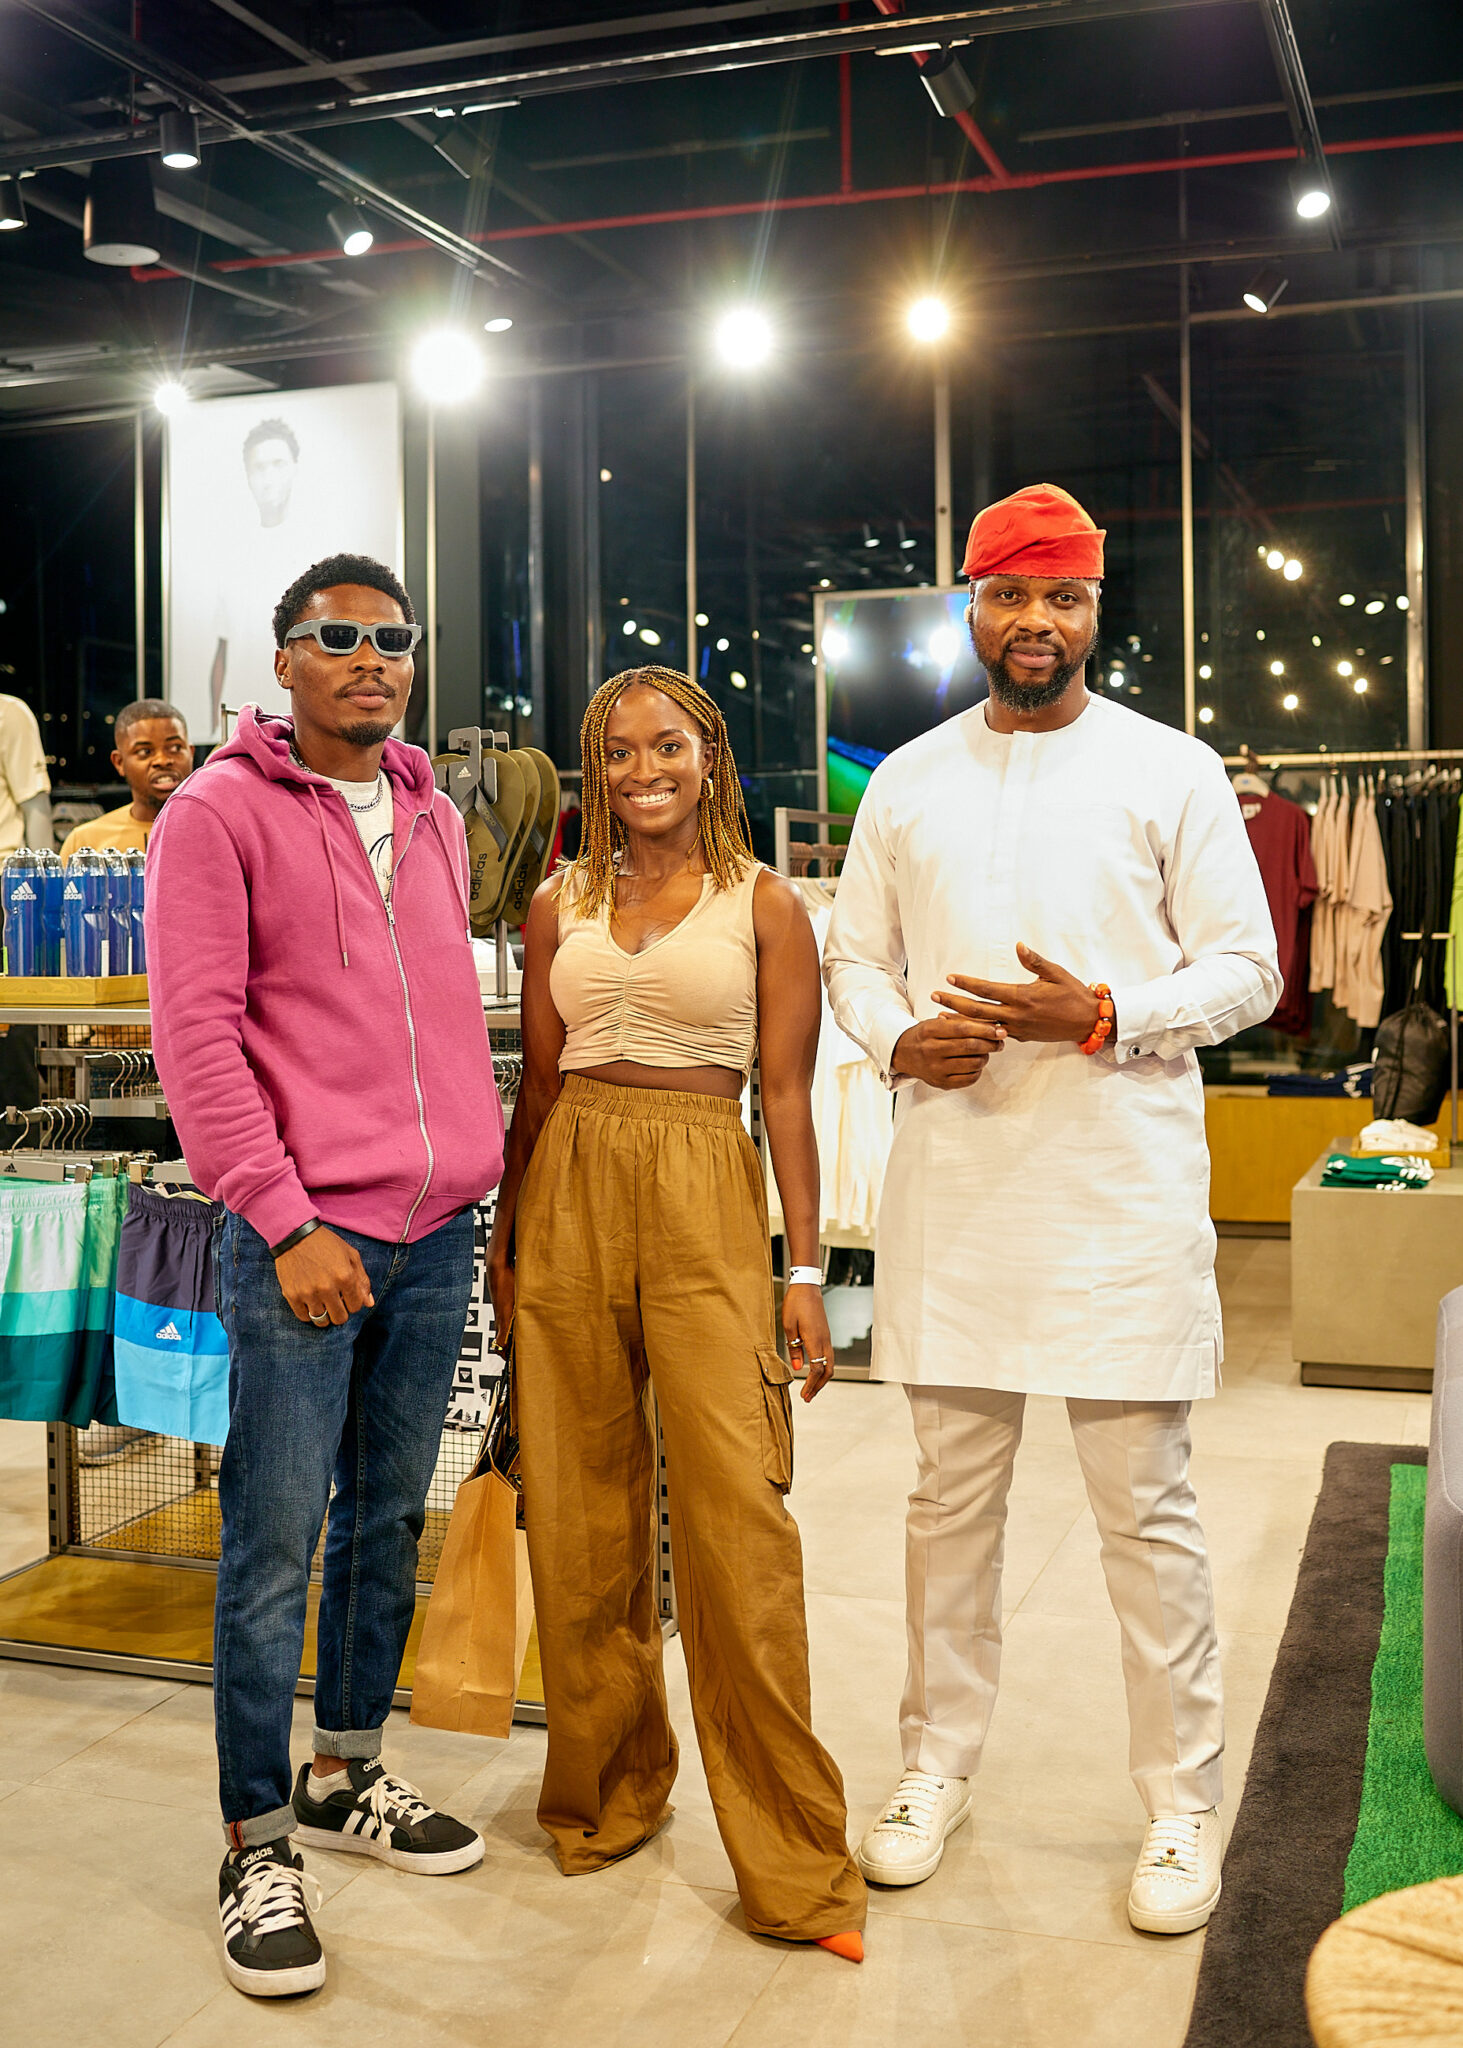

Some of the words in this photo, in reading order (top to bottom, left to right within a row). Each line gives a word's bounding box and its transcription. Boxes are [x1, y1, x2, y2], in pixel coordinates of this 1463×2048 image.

[470, 853, 488, 901] adidas
[514, 863, 529, 910] adidas
[10, 893, 37, 901] adidas
[156, 1332, 182, 1341] adidas
[240, 1846, 274, 1869] adidas
